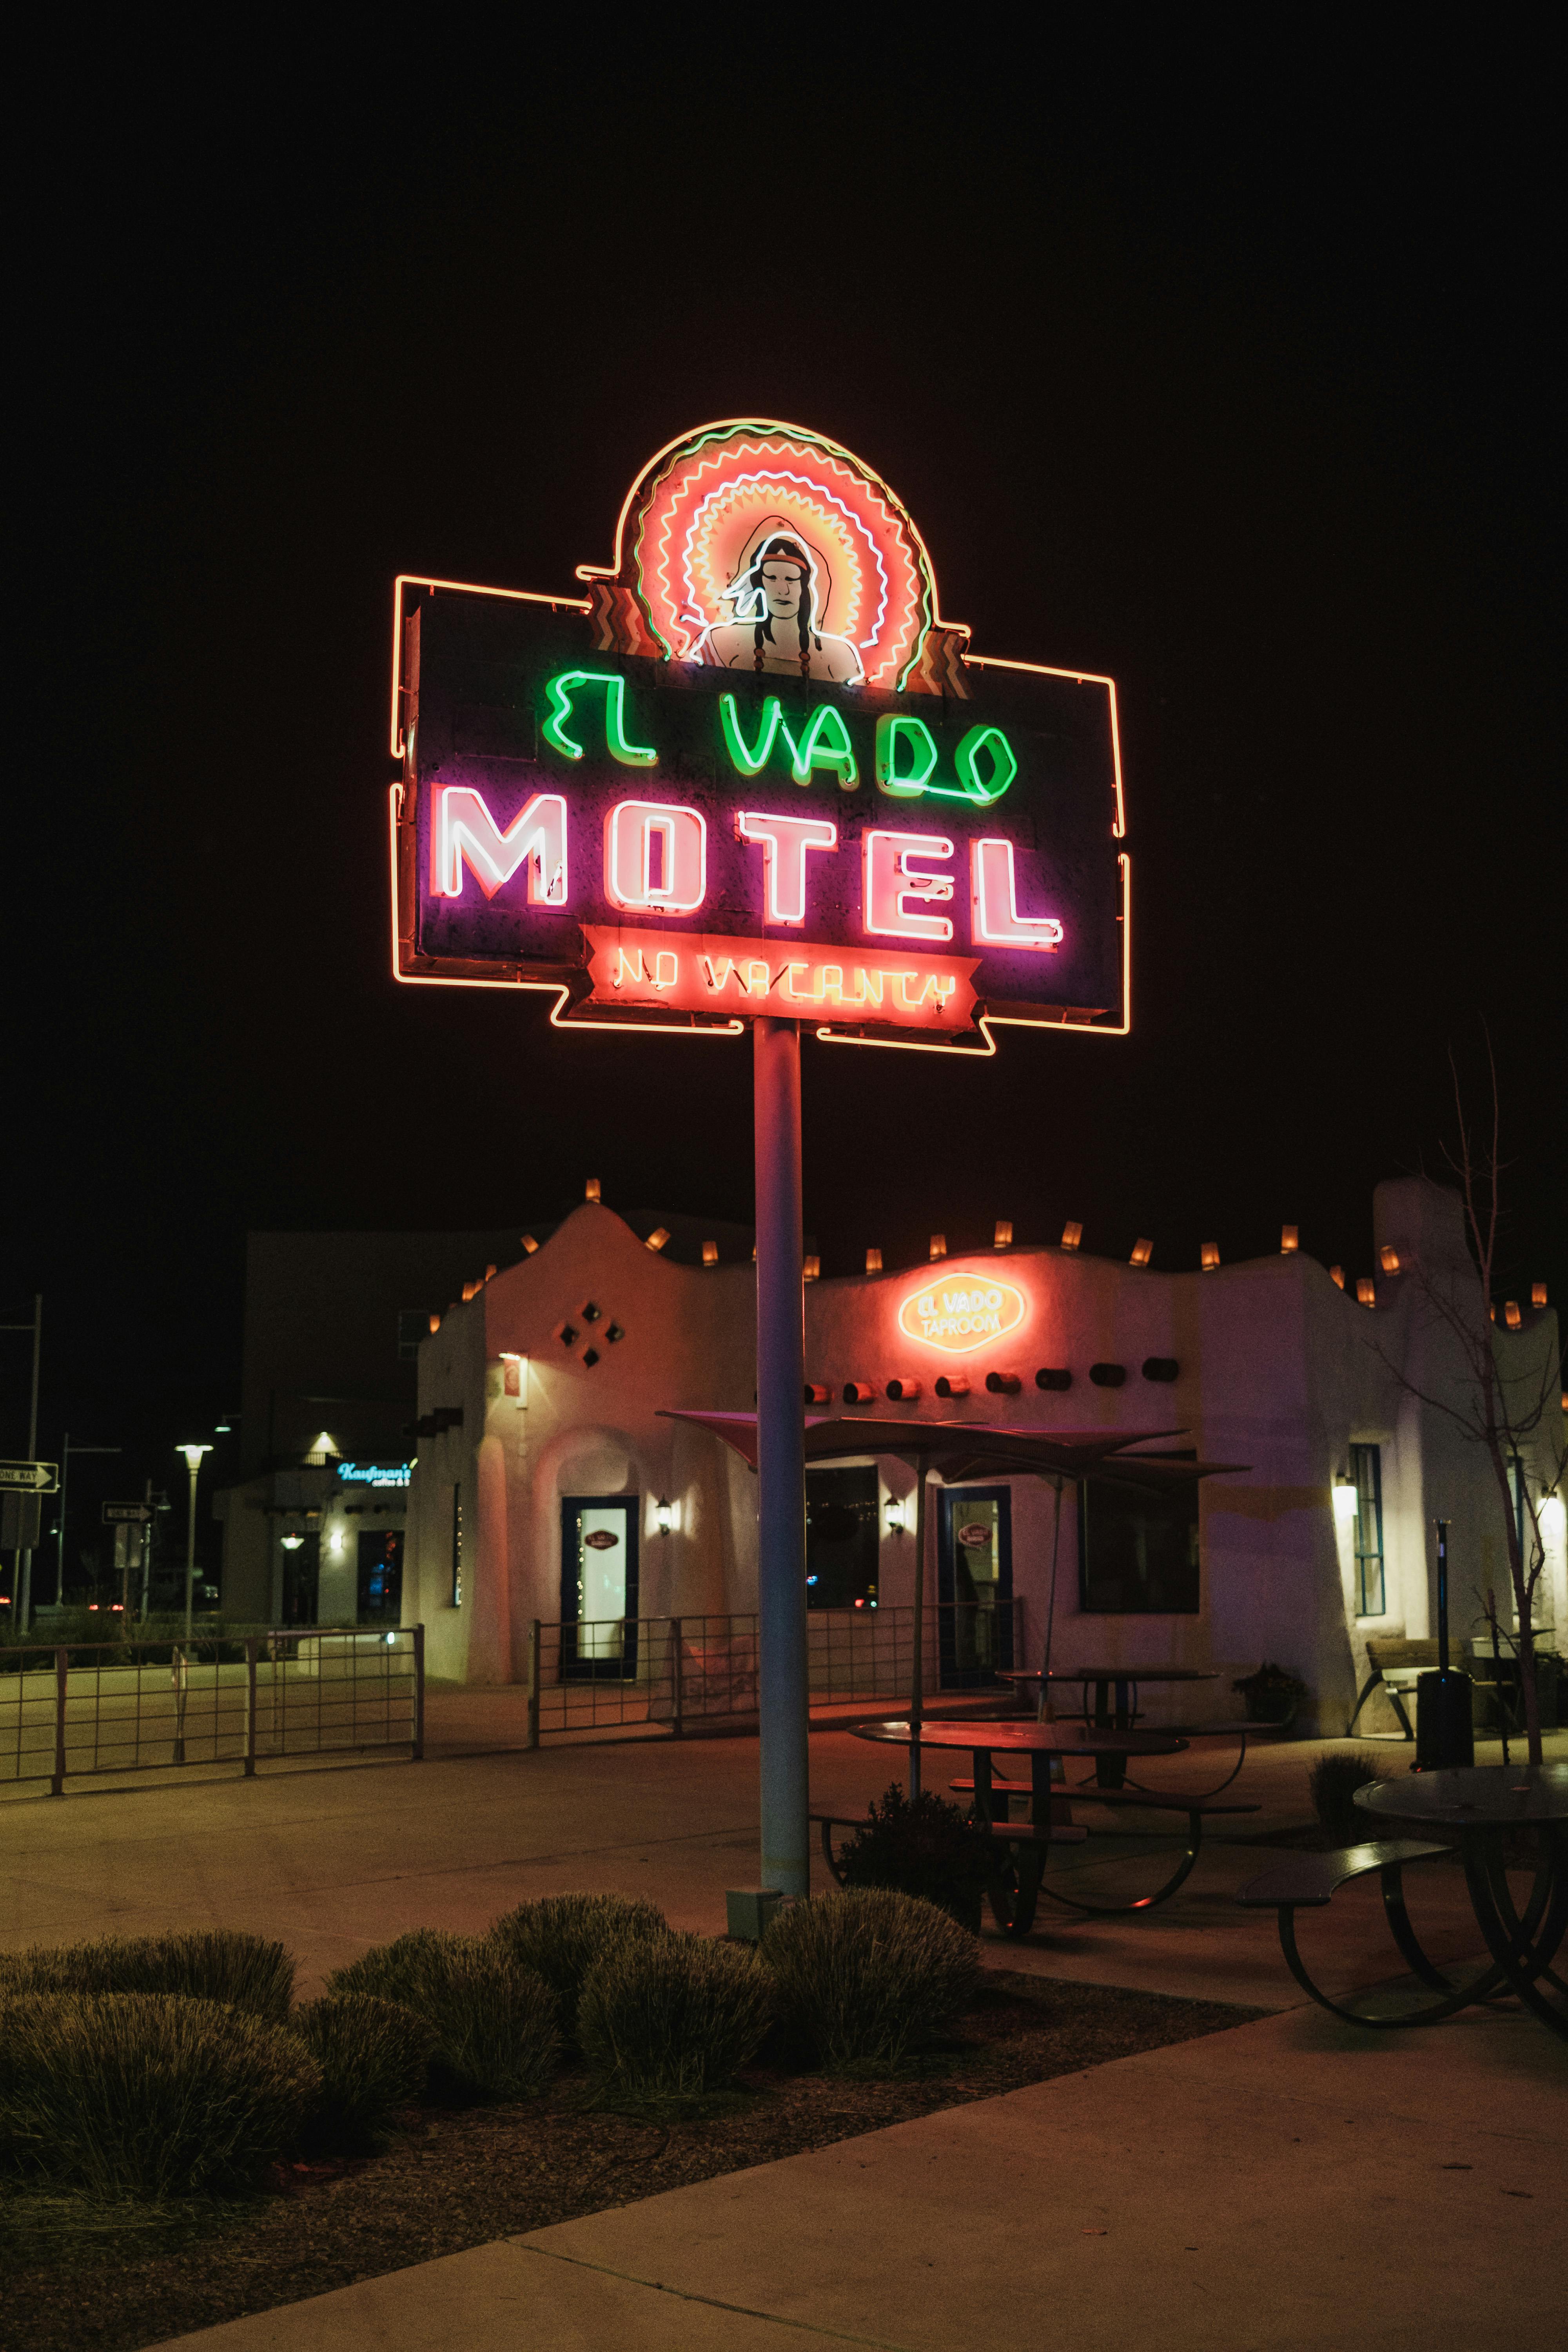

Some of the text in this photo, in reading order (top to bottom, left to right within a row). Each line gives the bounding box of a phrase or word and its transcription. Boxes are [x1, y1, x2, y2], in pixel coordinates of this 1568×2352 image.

[543, 671, 1018, 807] EL VADO
[431, 786, 1063, 950] MOTEL
[613, 947, 956, 1012] NO VACANCY
[943, 1290, 1002, 1313] VADO
[922, 1314, 1001, 1336] TAPROOM
[19, 1472, 37, 1481] WAY
